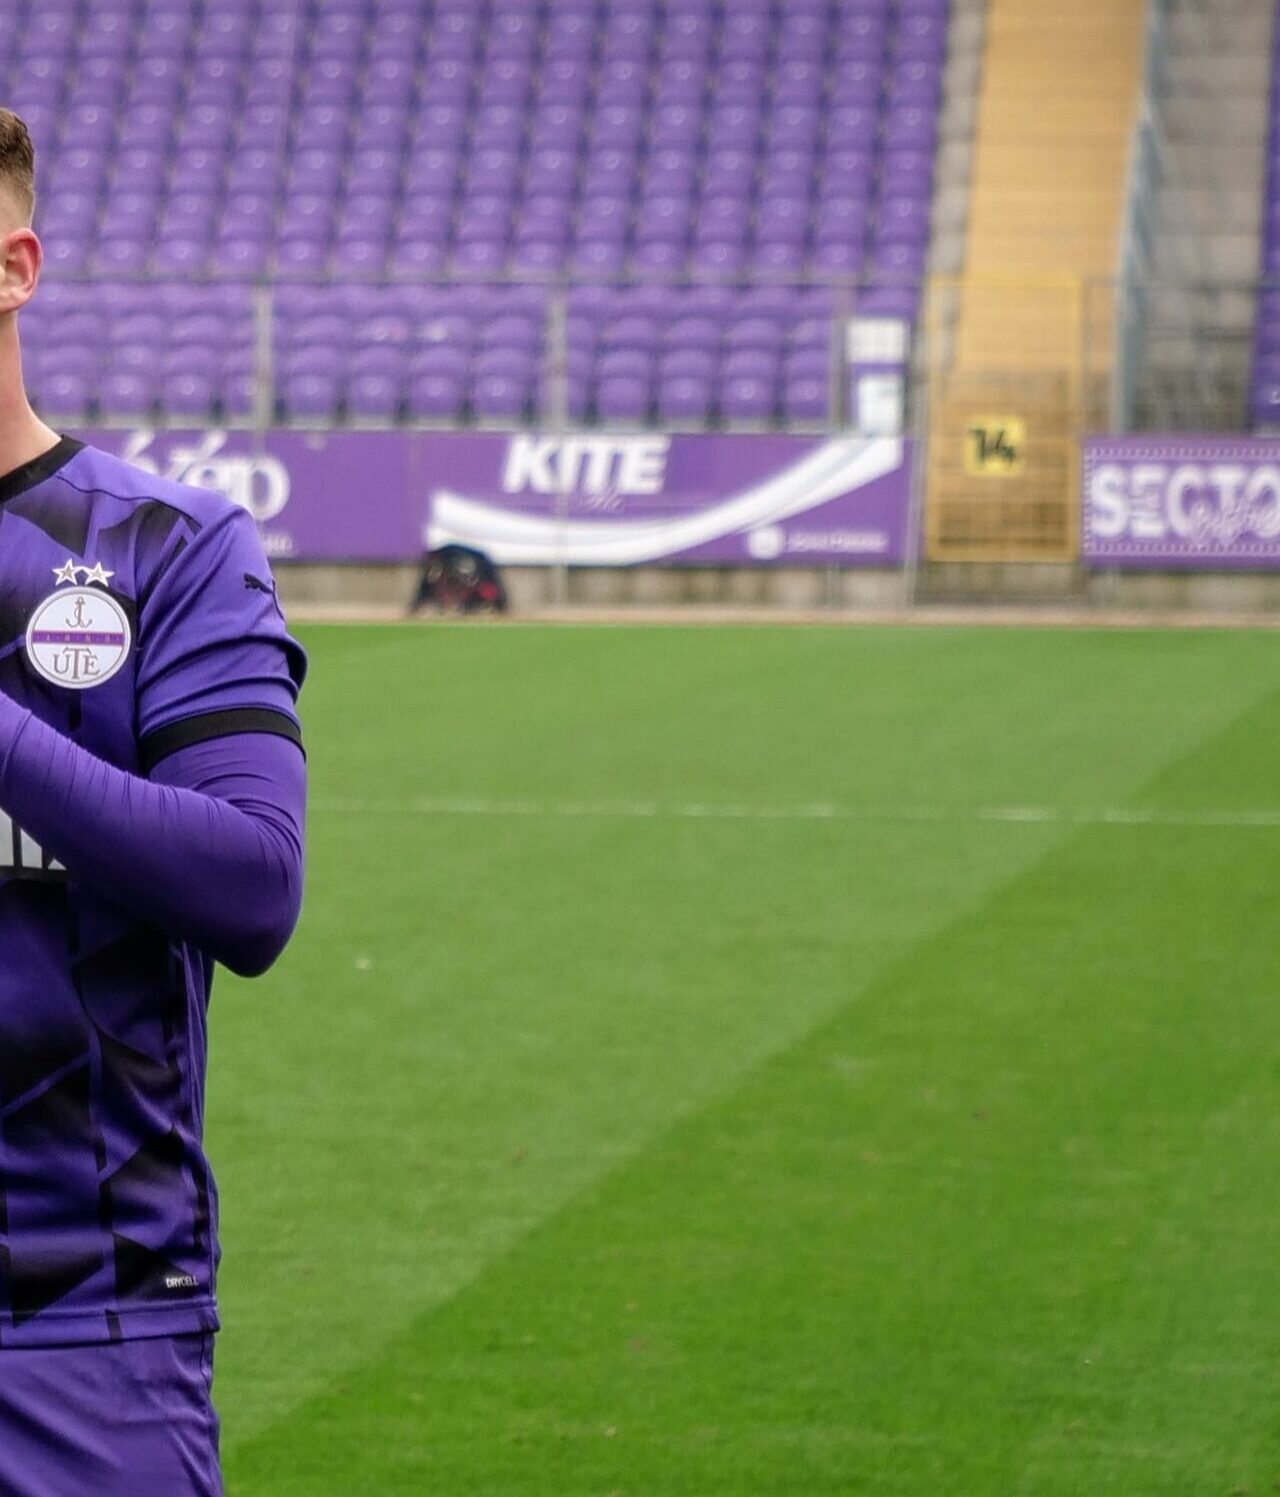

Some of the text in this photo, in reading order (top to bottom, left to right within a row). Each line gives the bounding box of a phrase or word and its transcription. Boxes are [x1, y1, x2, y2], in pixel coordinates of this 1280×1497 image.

[502, 433, 671, 494] KITE
[967, 427, 1017, 467] 14
[53, 646, 100, 680] UTE
